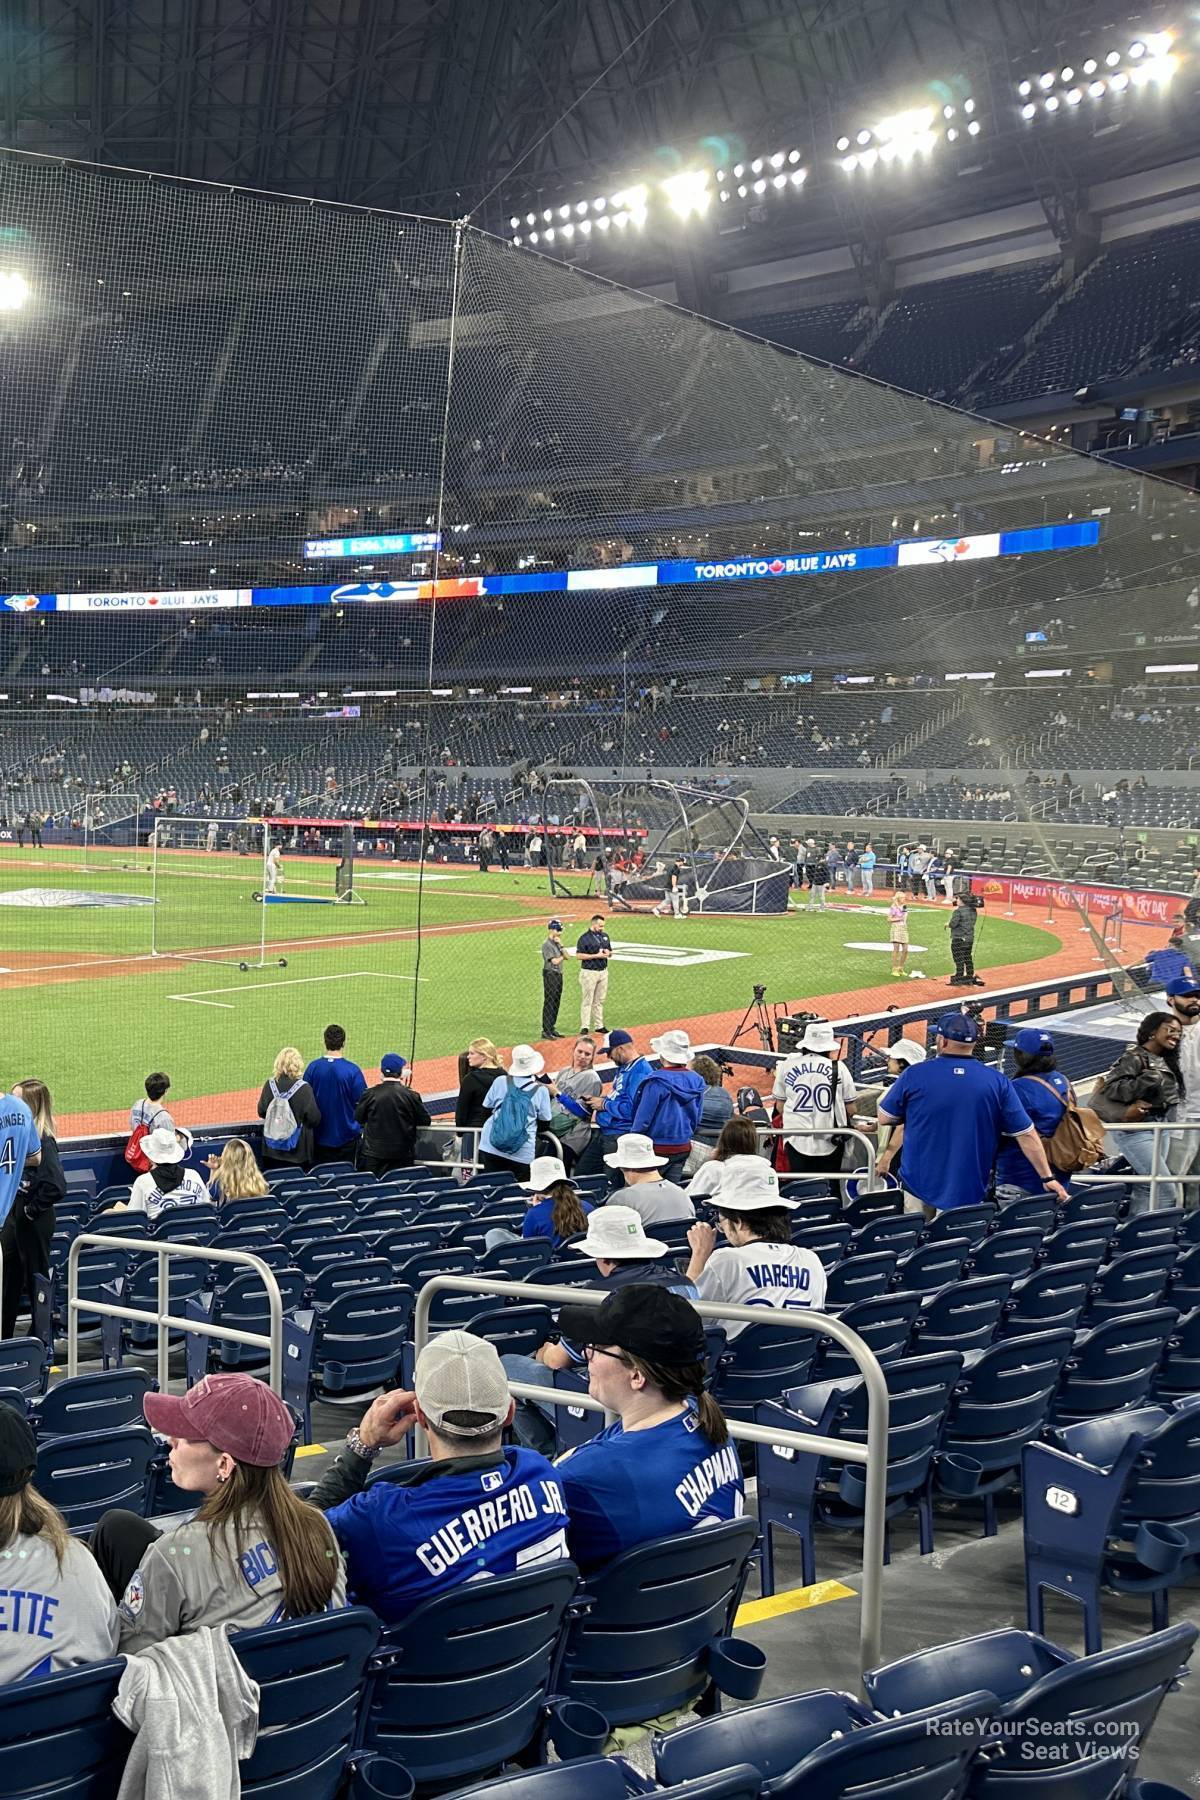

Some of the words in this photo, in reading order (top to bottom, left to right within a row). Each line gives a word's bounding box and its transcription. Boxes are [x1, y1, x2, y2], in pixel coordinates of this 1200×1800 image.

[695, 561, 769, 579] TORONTO
[785, 556, 819, 573] BLUE
[821, 553, 857, 570] JAYS
[87, 596, 146, 607] TORONTO
[191, 594, 219, 605] JAYS
[792, 1083, 833, 1113] 20
[746, 1263, 810, 1291] VARSHO
[675, 1446, 739, 1517] CHAPMAN
[1052, 1492, 1070, 1508] 12
[415, 1484, 538, 1577] GUERRERO
